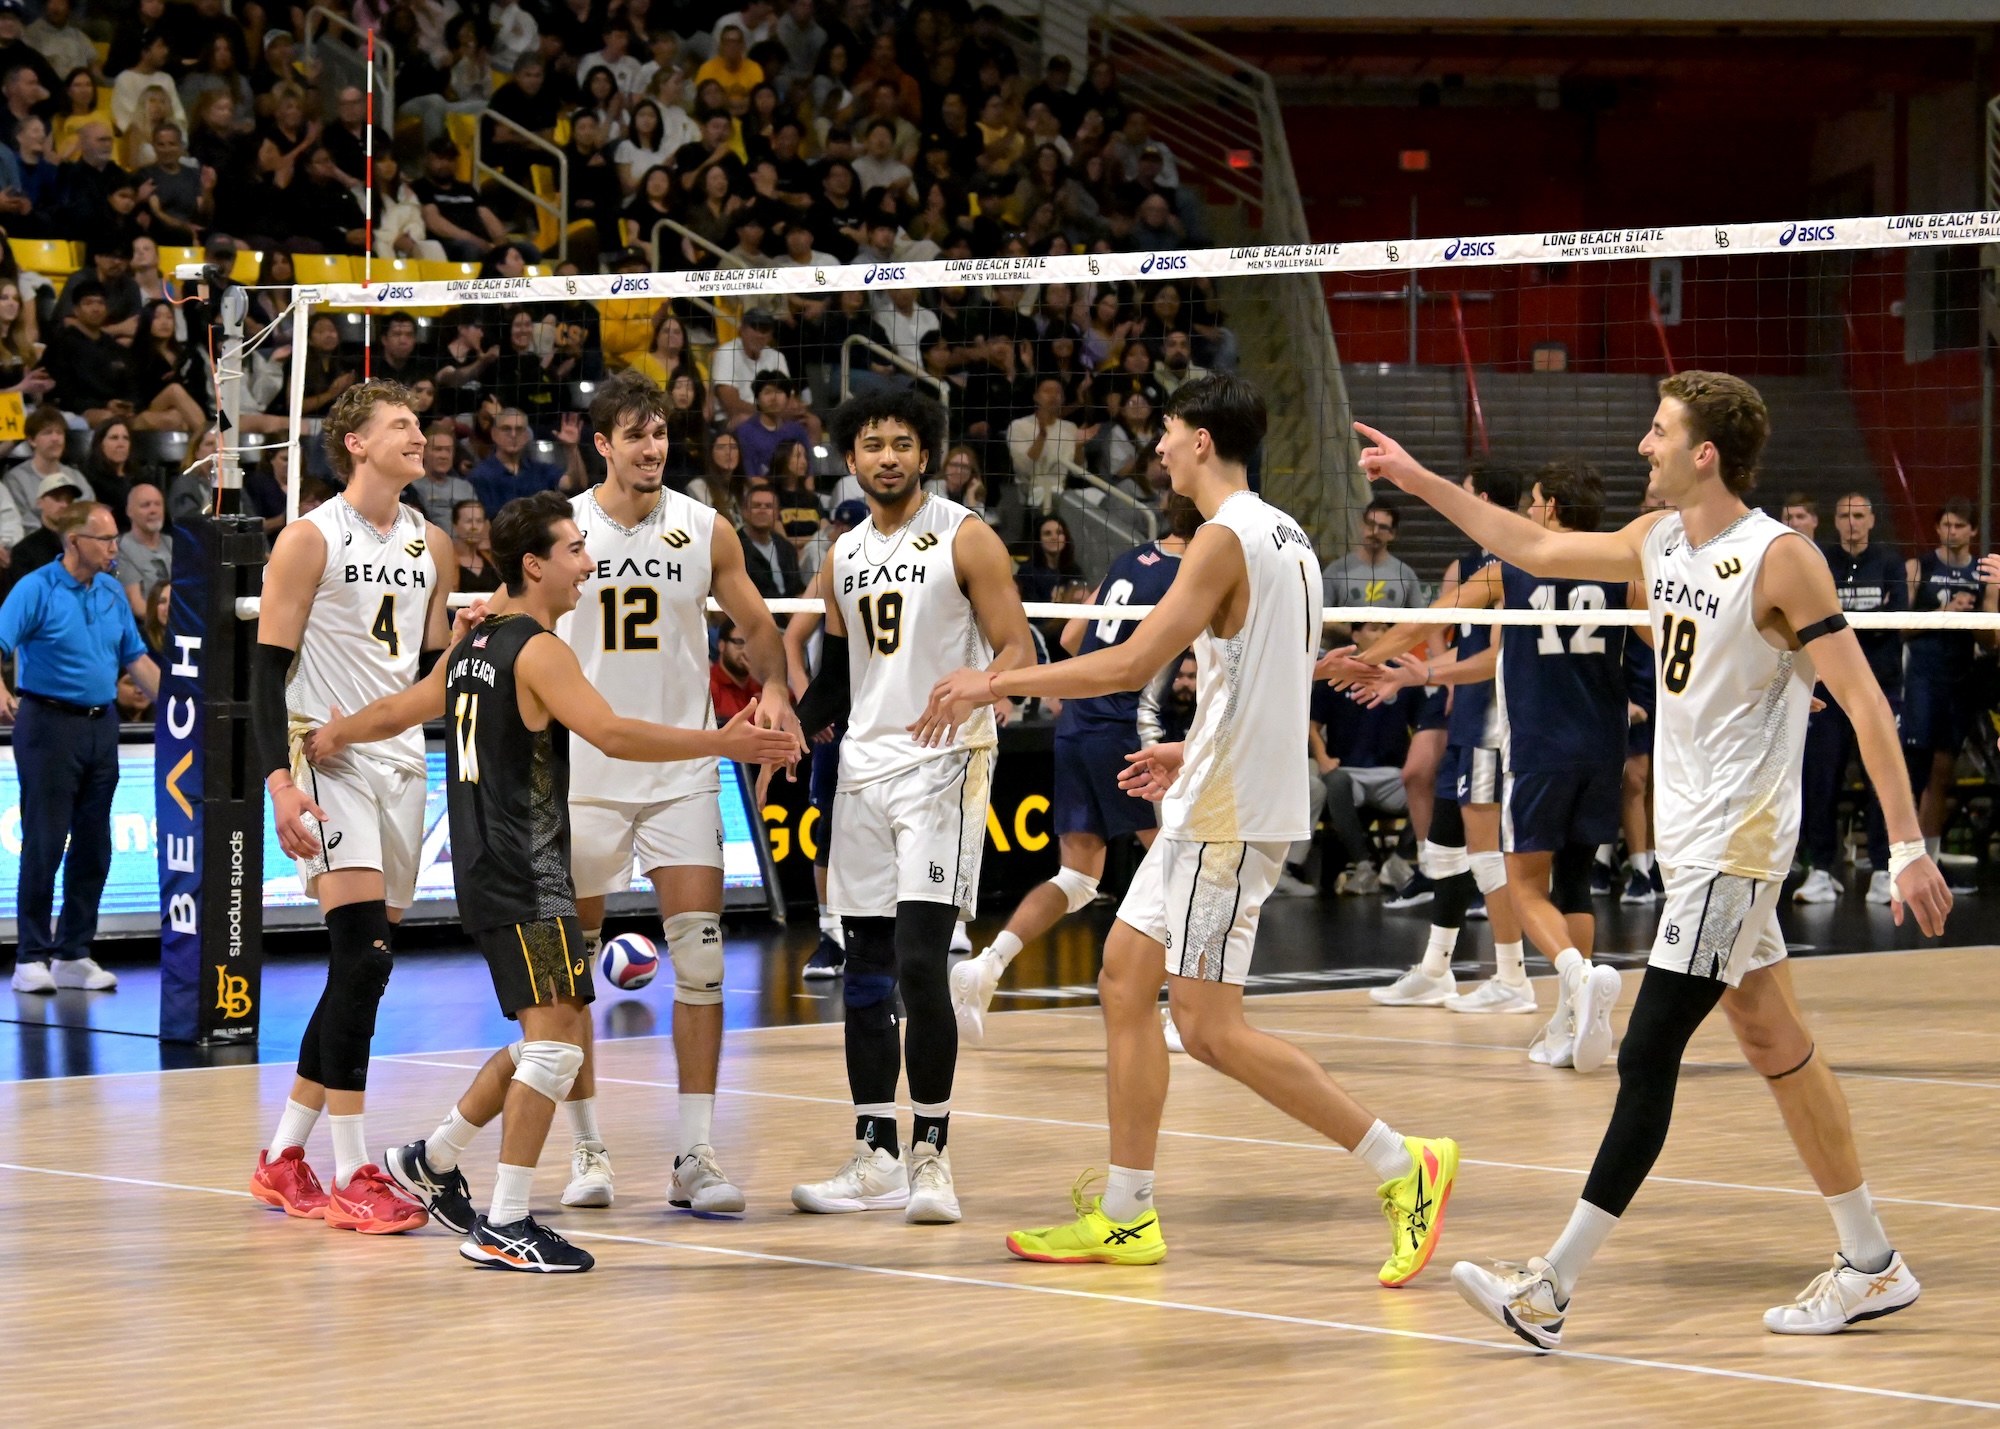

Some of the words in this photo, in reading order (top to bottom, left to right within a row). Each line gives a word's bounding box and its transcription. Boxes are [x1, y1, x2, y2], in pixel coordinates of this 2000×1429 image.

[1887, 215, 1924, 229] LONG
[1928, 213, 1974, 227] BEACH
[1908, 230, 1938, 240] MEN'S
[1941, 227, 2000, 239] VOLLEYBALL
[1230, 247, 1260, 259] LONG
[1263, 245, 1301, 258] BEACH
[1304, 243, 1341, 255] STATE
[1542, 233, 1577, 246] LONG
[1580, 231, 1621, 244] BEACH
[1625, 229, 1665, 242] STATE
[1561, 247, 1589, 256] MEN'S
[1592, 244, 1647, 255] VOLLEYBALL
[685, 272, 710, 282] LONG
[713, 270, 745, 281] BEACH
[748, 268, 778, 280] STATE
[944, 260, 973, 271] LONG
[975, 259, 1010, 270] BEACH
[1014, 257, 1047, 269] STATE
[960, 273, 983, 281] MEN'S
[985, 271, 1031, 281] VOLLEYBALL
[1247, 260, 1272, 269] MEN'S
[1274, 258, 1324, 268] VOLLEYBALL
[447, 280, 469, 291] LONG
[472, 279, 501, 290] BEACH
[505, 278, 531, 289] STATE
[459, 292, 479, 300] MEN'S
[481, 291, 519, 299] VOLLEYBALL
[699, 284, 720, 292] MEN'S
[722, 282, 764, 291] VOLLEYBALL
[345, 564, 426, 588] BEACH
[587, 558, 681, 582] EACH
[844, 564, 925, 595] BEACH
[1300, 560, 1310, 654] 1
[1654, 579, 1720, 619] BEACH
[370, 593, 400, 659] 4
[599, 585, 660, 652] 12
[858, 590, 903, 657] 19
[1528, 585, 1606, 655] 12
[1661, 612, 1697, 695] 18
[472, 658, 496, 688] EACH
[455, 693, 479, 784] 11
[166, 635, 202, 935] BEACH
[229, 831, 243, 886] sports
[228, 888, 243, 957] imports
[215, 965, 252, 1019] LB
